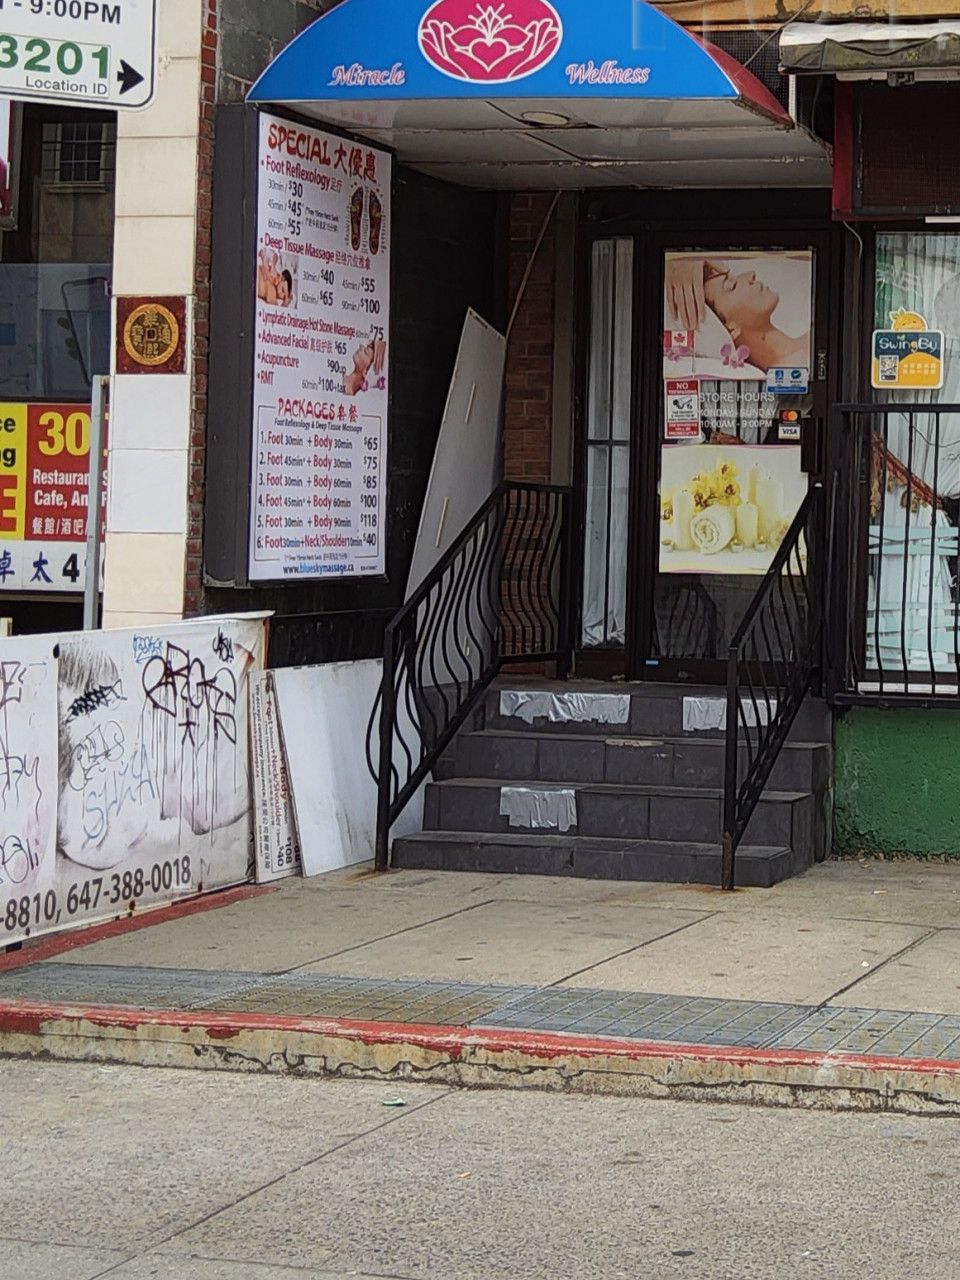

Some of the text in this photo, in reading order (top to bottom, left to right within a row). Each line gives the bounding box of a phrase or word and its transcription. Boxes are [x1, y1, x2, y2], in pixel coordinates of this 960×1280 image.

[327, 62, 406, 86] Miracle
[565, 60, 651, 85] Wellness
[26, 76, 107, 96] Location ID
[268, 123, 331, 166] SPECIAL
[266, 155, 285, 175] Foot
[286, 160, 331, 191] Reflexology
[288, 180, 303, 198] $30
[264, 233, 335, 263] Deep Tissue Massage
[320, 269, 335, 285] $40
[361, 277, 375, 293] $55
[320, 290, 333, 306] $65
[360, 298, 380, 314] $100
[334, 321, 356, 340] Massage
[370, 323, 384, 341] $75
[261, 329, 291, 347] Advanced
[292, 334, 309, 350] Facial
[334, 341, 347, 355] $65
[879, 334, 937, 353] SwingBy
[261, 349, 299, 368] Acupuncture
[260, 370, 274, 385] RMT
[676, 382, 689, 390] NO
[699, 392, 775, 402] STORE HOURS
[278, 397, 335, 420] PACKAGES
[741, 408, 776, 417] SUNDAY
[268, 431, 283, 445] Foot
[314, 434, 332, 451] Body
[363, 436, 378, 450] $65
[267, 452, 283, 466] Foot
[314, 455, 332, 471] Body
[363, 456, 378, 470] $75
[33, 469, 89, 486] Restauran
[267, 473, 283, 486] Foot
[314, 474, 332, 490] Body
[363, 476, 377, 489] $85
[34, 490, 67, 509] Cafe,
[266, 494, 282, 507] Foot
[313, 495, 332, 510] Body
[360, 495, 377, 508] $100
[265, 515, 282, 528] Foot
[314, 515, 332, 530] Body
[360, 514, 377, 527] $118
[363, 534, 376, 546] $40
[283, 563, 354, 575] www.blueskymassage.ca
[67, 855, 191, 915] 647-388-0018
